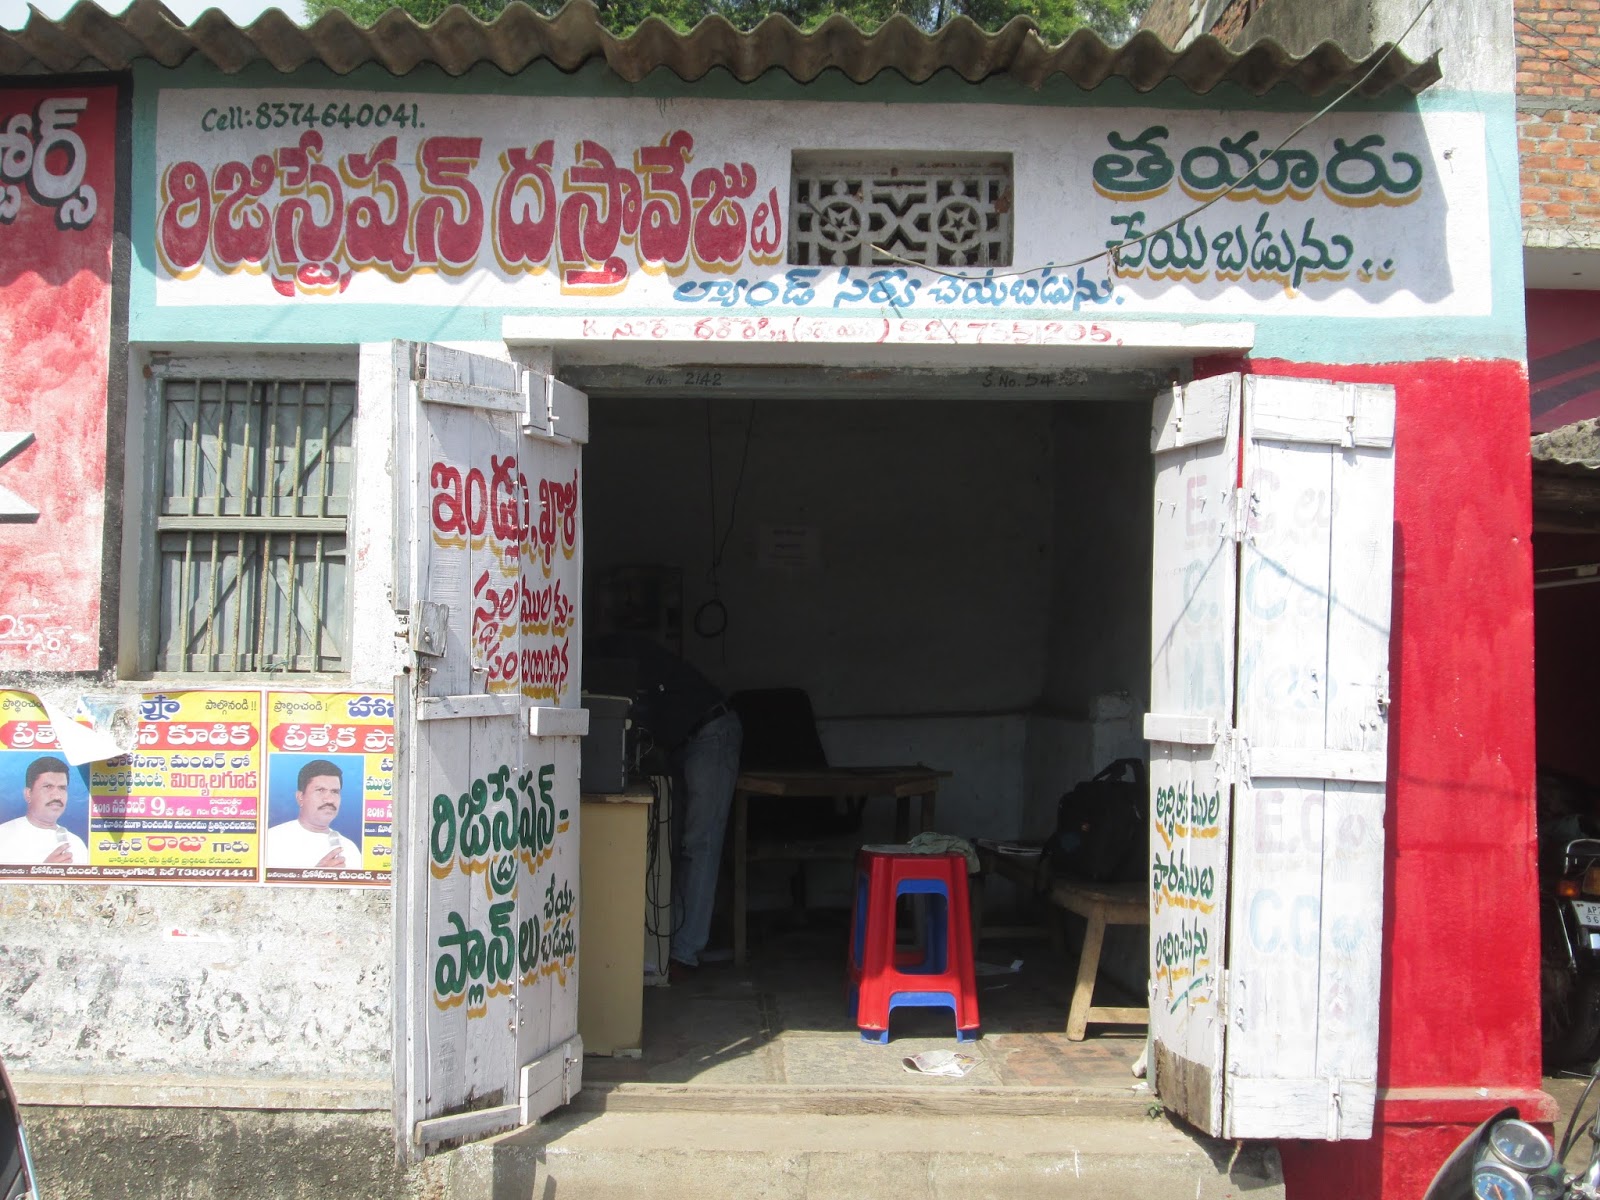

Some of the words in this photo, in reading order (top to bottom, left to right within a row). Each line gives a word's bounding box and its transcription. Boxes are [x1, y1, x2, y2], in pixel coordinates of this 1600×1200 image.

[1093, 125, 1423, 200] తయారు
[685, 372, 722, 386] 2142
[167, 723, 251, 746] కూడిక
[145, 835, 207, 853] రాజు
